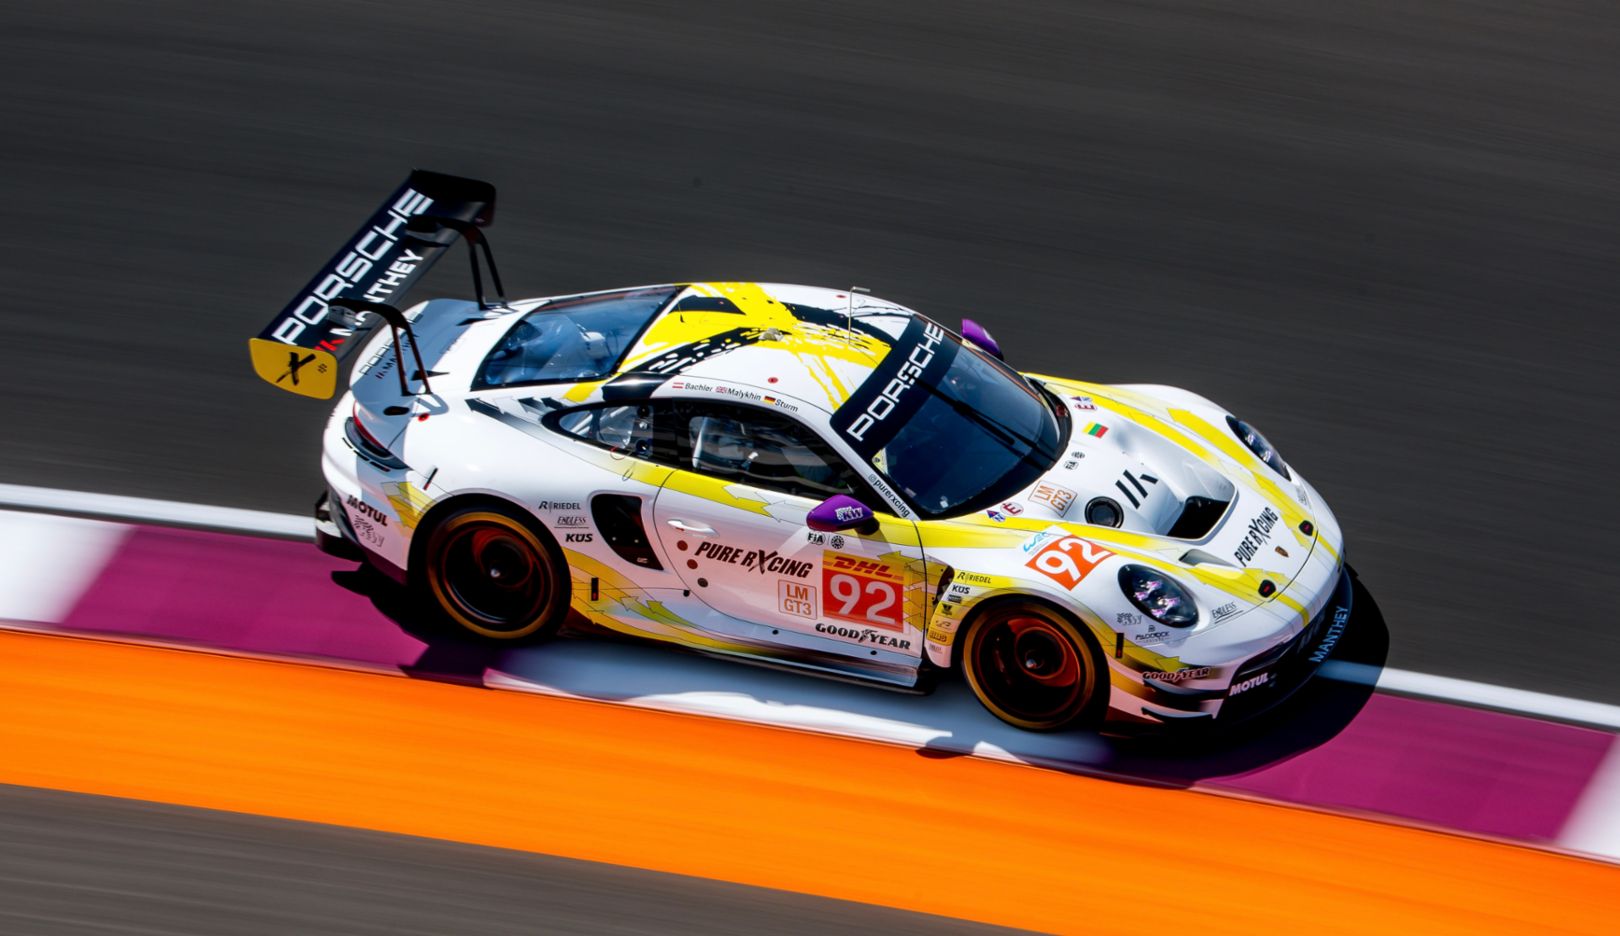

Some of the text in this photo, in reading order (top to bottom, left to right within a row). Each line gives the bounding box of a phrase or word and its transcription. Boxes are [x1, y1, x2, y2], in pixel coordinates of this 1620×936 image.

[271, 187, 434, 346] PORSCHE
[846, 322, 945, 442] PORSCHE
[684, 382, 799, 413] Bachler Malykhin Sturm
[1034, 485, 1055, 501] LM
[1050, 489, 1073, 512] GT3
[347, 495, 388, 527] MOTUL
[553, 502, 581, 511] RIEDEL
[557, 516, 587, 526] ENDLESS
[1234, 506, 1279, 568] PURE RXCING
[694, 541, 813, 579] PURE RXCING
[831, 555, 895, 579] DHL
[1034, 536, 1111, 582] 92
[786, 583, 809, 600] LM
[969, 575, 992, 584] RIEDEL
[783, 598, 812, 616] GT3
[829, 573, 896, 624] 92
[1211, 601, 1238, 619] ENDLESS
[815, 623, 911, 651] GOODYEAR
[1308, 605, 1349, 663] MANTHEY
[1142, 667, 1211, 683] GOODYEAR
[1229, 672, 1271, 697] MOTUL
